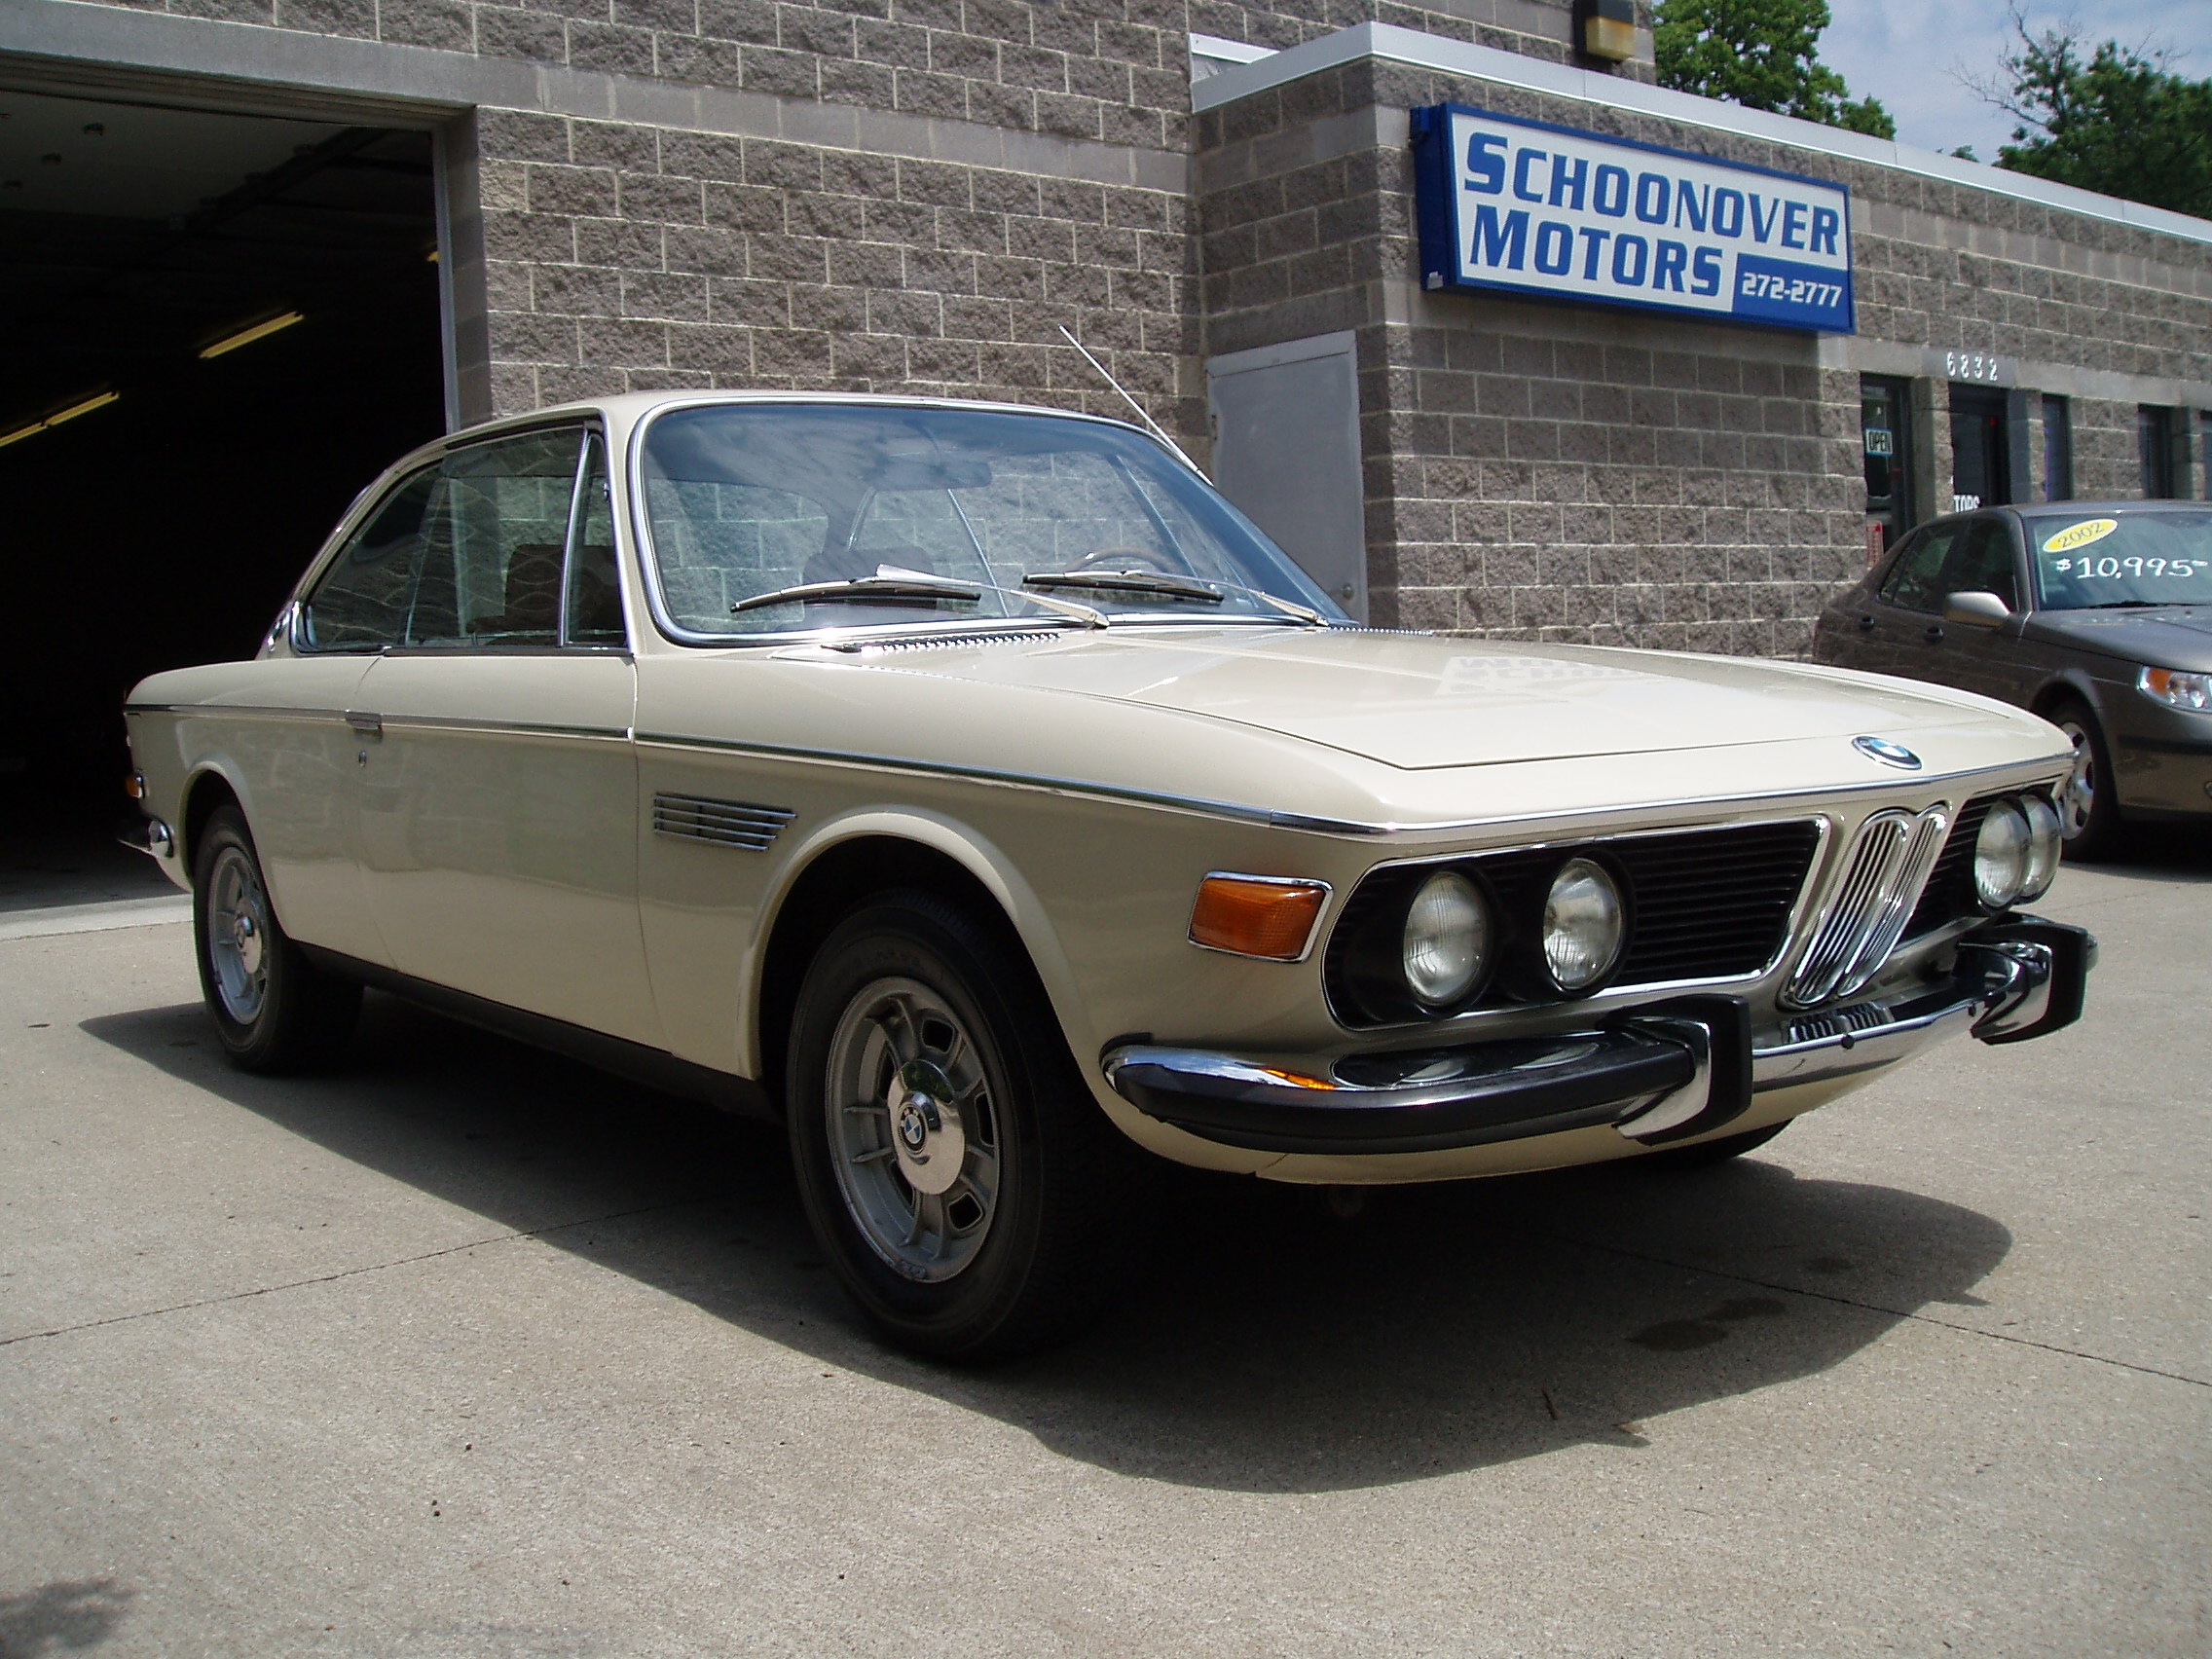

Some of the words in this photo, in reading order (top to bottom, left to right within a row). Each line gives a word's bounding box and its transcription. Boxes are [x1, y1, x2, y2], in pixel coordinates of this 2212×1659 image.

[1464, 131, 1839, 255] SCHOONOVER
[1469, 203, 1722, 297] MOTORS
[1742, 272, 1842, 308] 272-2777
[1947, 351, 1998, 382] 6832
[1868, 431, 1891, 452] OPEN
[2057, 521, 2105, 549] 2002
